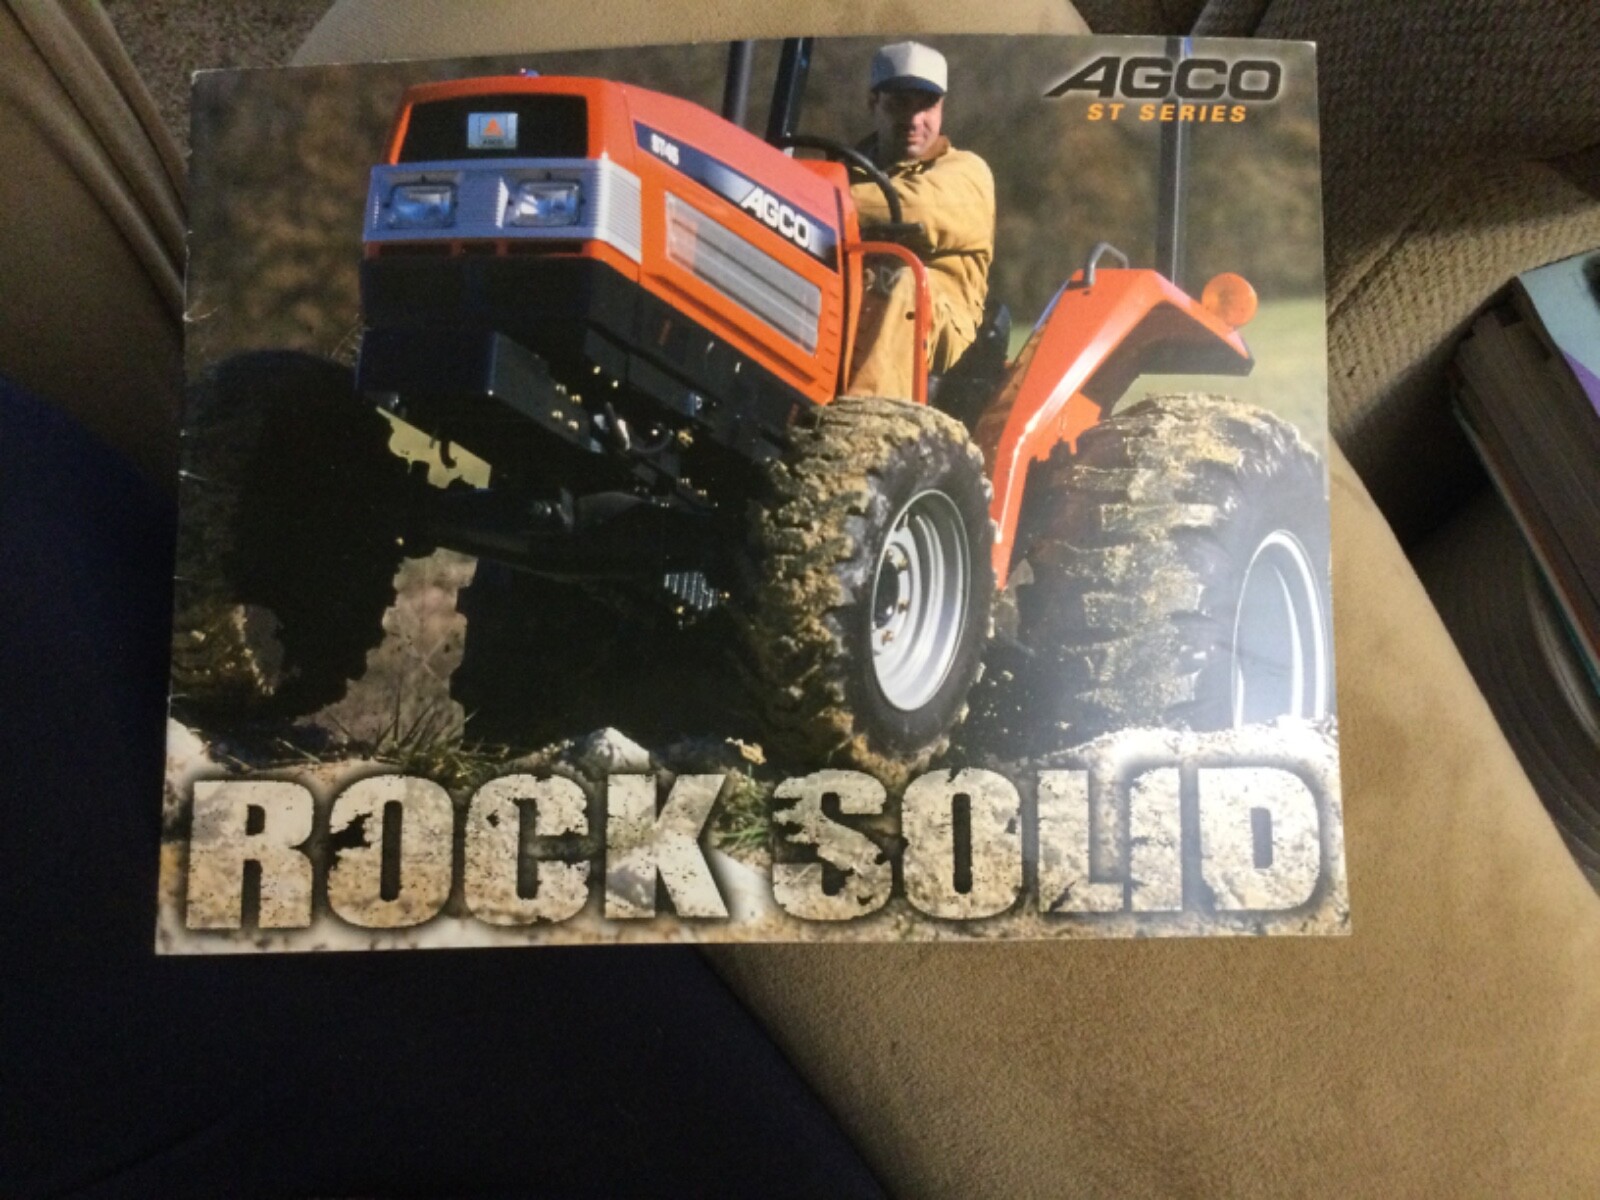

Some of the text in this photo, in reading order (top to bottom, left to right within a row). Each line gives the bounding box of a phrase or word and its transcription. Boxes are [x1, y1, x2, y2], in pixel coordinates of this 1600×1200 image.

[1044, 56, 1281, 100] AGCO
[1087, 104, 1247, 122] ST SERIES
[740, 186, 811, 248] AGCO
[186, 766, 1320, 929] ROCK SOLID
